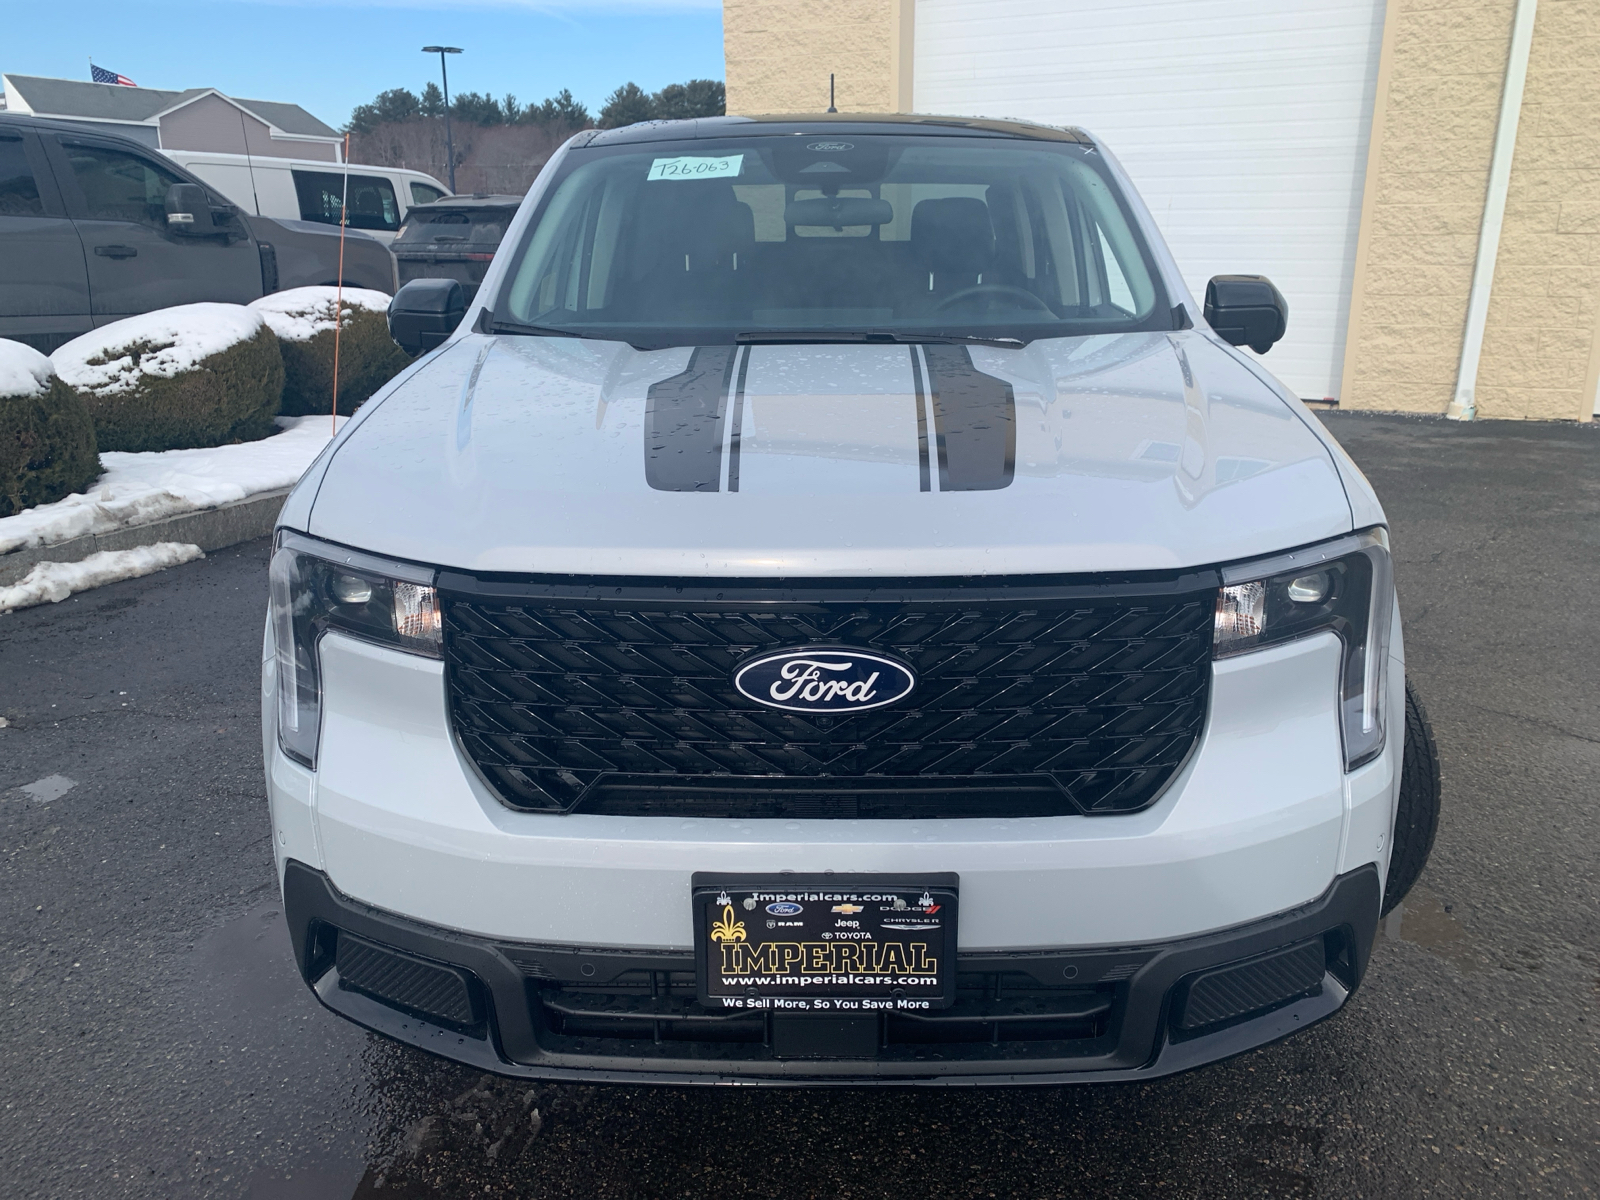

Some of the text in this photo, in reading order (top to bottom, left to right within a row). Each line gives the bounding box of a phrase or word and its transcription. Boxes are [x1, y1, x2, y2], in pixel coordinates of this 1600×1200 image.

[654, 160, 729, 176] T26-063
[770, 660, 880, 701] Ford
[752, 892, 898, 902] Imperialcars.com
[835, 919, 860, 928] Jeep
[721, 942, 937, 974] IMPERIAL
[722, 975, 938, 986] www.imperialcars.com
[722, 998, 930, 1010] We Sell More, So You Save More
